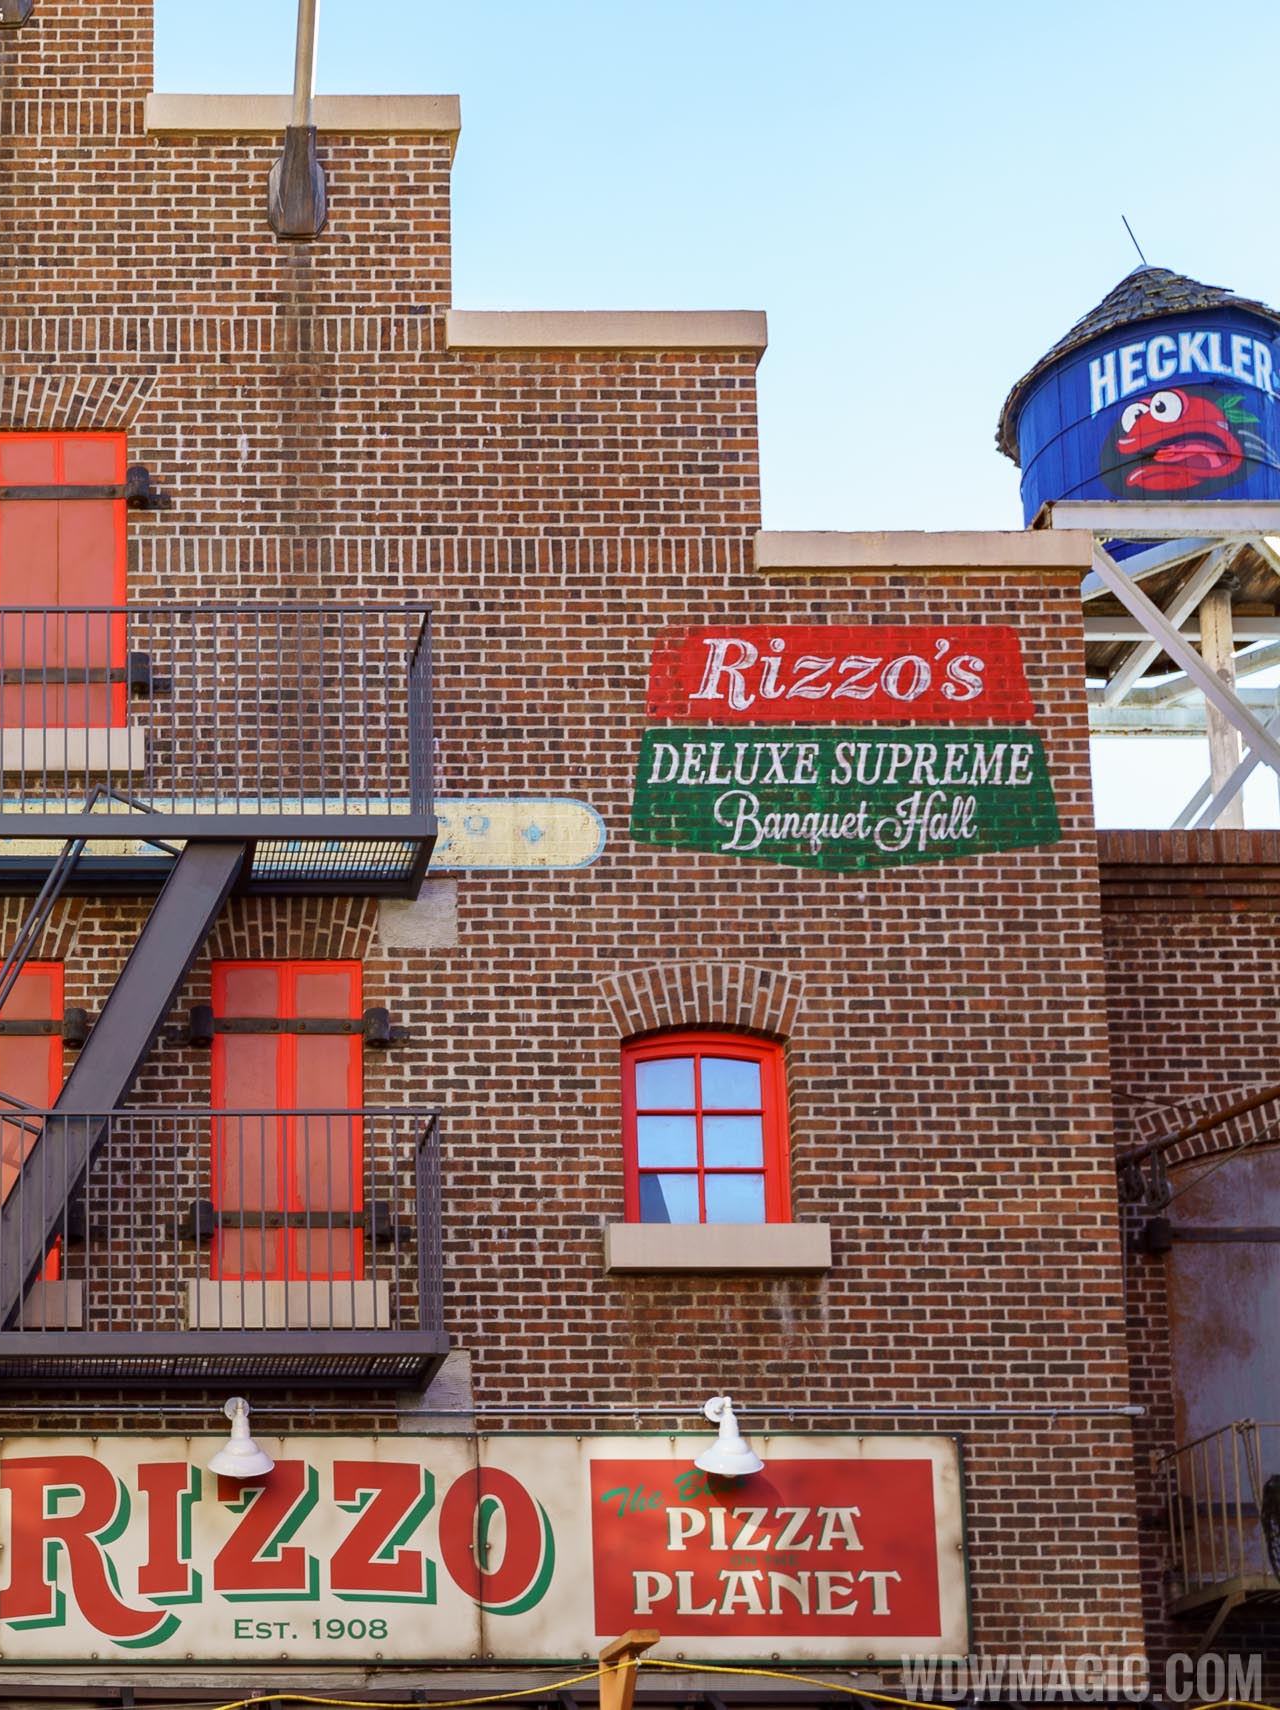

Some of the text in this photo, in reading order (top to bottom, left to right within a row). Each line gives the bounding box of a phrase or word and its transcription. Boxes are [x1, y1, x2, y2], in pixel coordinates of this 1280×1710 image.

[1089, 331, 1280, 418] HECKLER
[689, 637, 985, 711] Rizzo's
[648, 742, 1033, 786] DELUXE SUPREME
[714, 790, 977, 855] Banquet Hall
[601, 1484, 663, 1518] The
[665, 1506, 864, 1551] PIZZA
[730, 1554, 799, 1566] ON THE
[631, 1569, 902, 1616] PLANET
[313, 1619, 388, 1640] 1908
